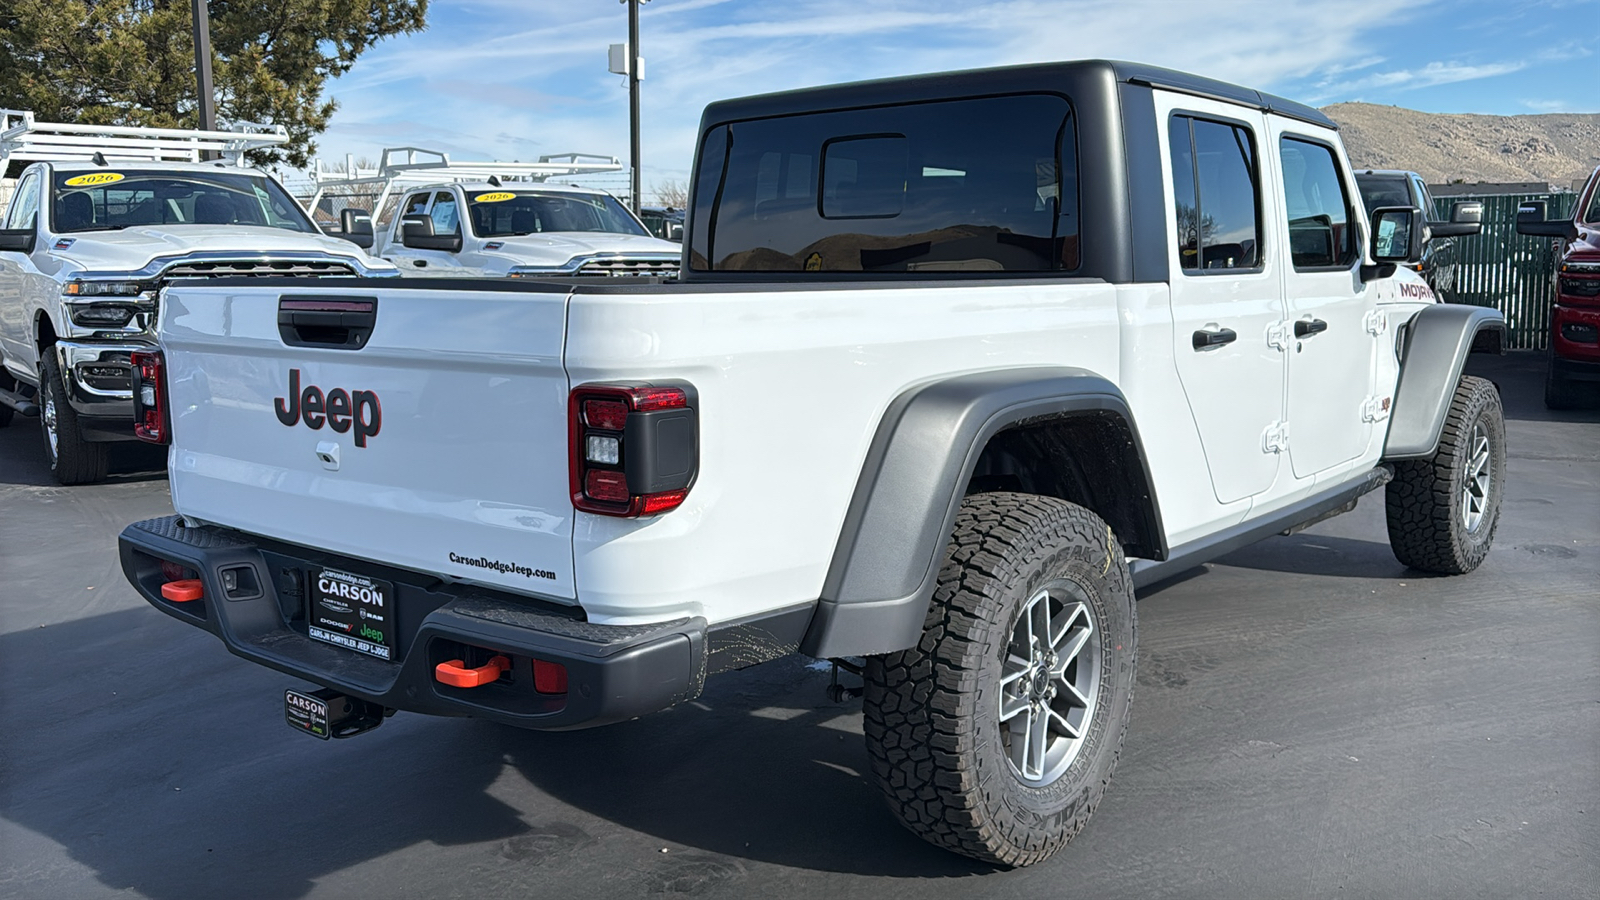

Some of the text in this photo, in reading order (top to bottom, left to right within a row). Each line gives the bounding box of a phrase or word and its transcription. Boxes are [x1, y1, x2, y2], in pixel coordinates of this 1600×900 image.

[78, 175, 113, 184] 2026
[484, 193, 509, 201] 2026
[274, 368, 382, 448] Jeep
[449, 551, 556, 580] CarsonDodgeJeep.com
[318, 579, 384, 607] CARSON
[323, 597, 349, 608] CHRYSLER
[320, 617, 349, 630] DODGE
[366, 612, 384, 621] RAM
[360, 623, 384, 642] Jeep
[330, 634, 356, 648] CHRYSLER
[357, 641, 370, 652] JEEP
[286, 693, 325, 717] CARSON
